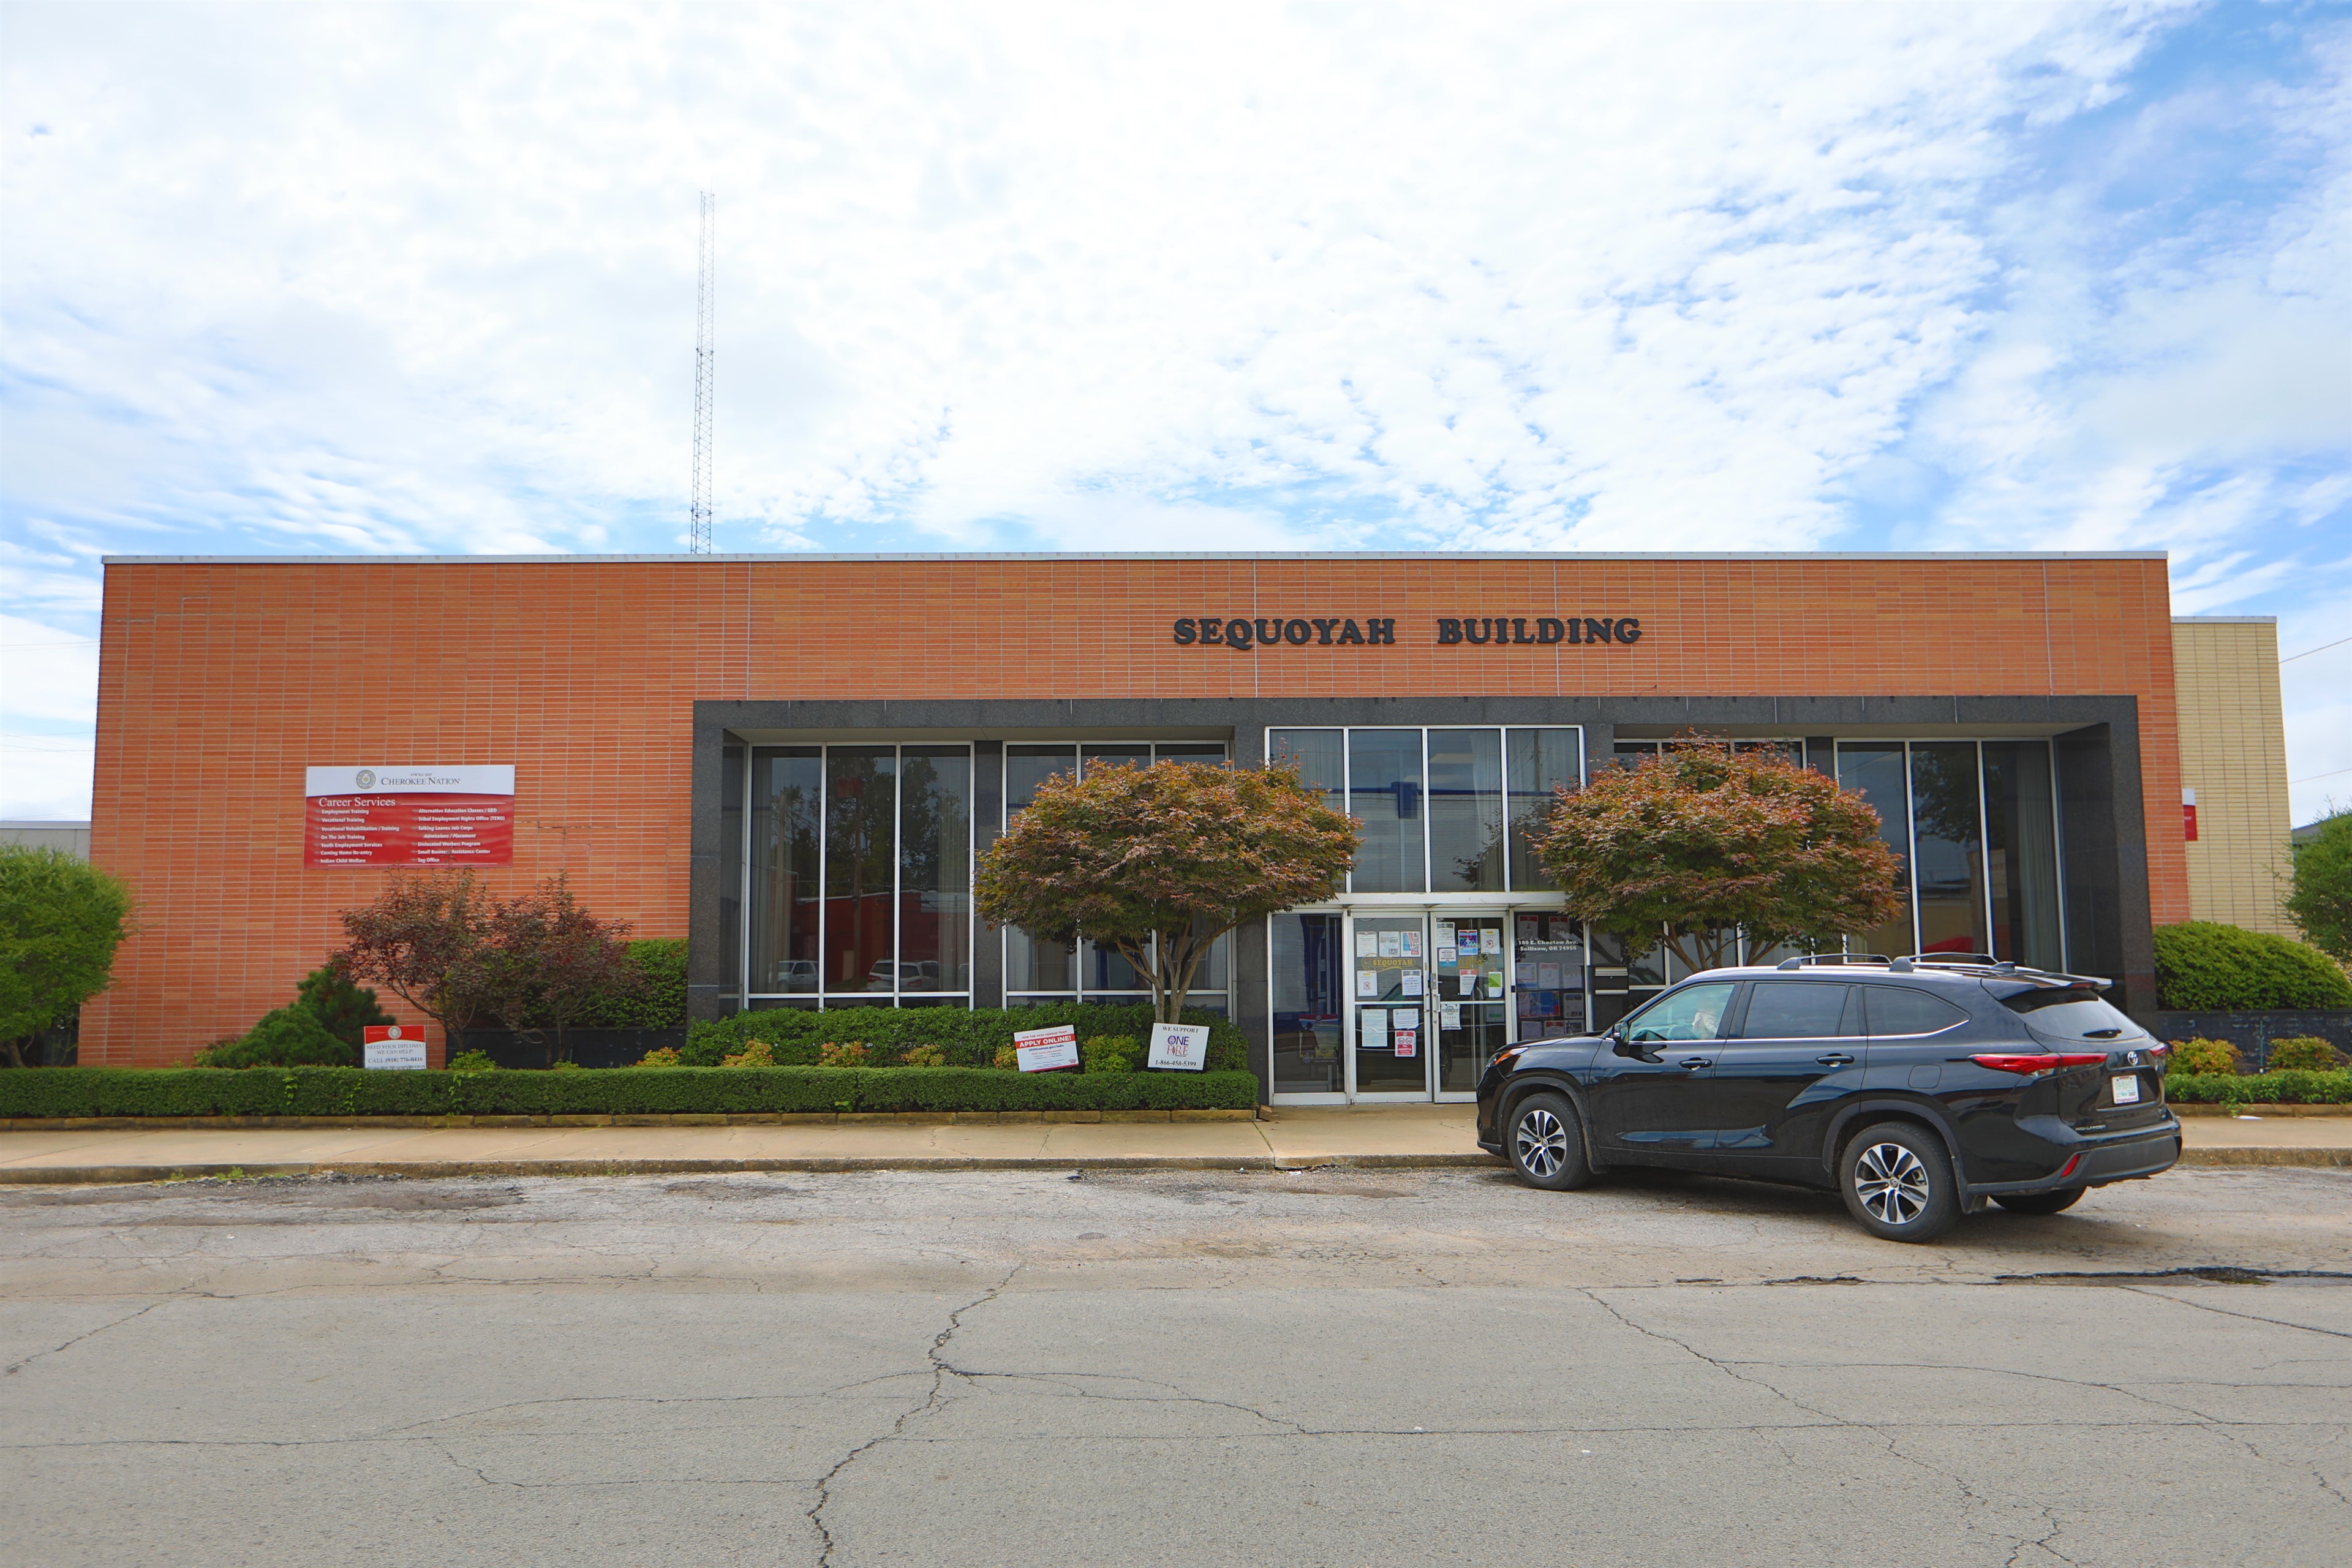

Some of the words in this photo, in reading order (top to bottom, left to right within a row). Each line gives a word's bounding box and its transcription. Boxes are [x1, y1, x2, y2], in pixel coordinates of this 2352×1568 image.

[1174, 618, 1396, 650] SEQUOYAH
[1437, 618, 1642, 644] BUILDING
[381, 777, 427, 786] CHEROKEE
[318, 797, 352, 807] Career
[355, 797, 396, 807] Services
[1042, 1035, 1072, 1044] ONLINE!
[1167, 1035, 1189, 1046] ONE
